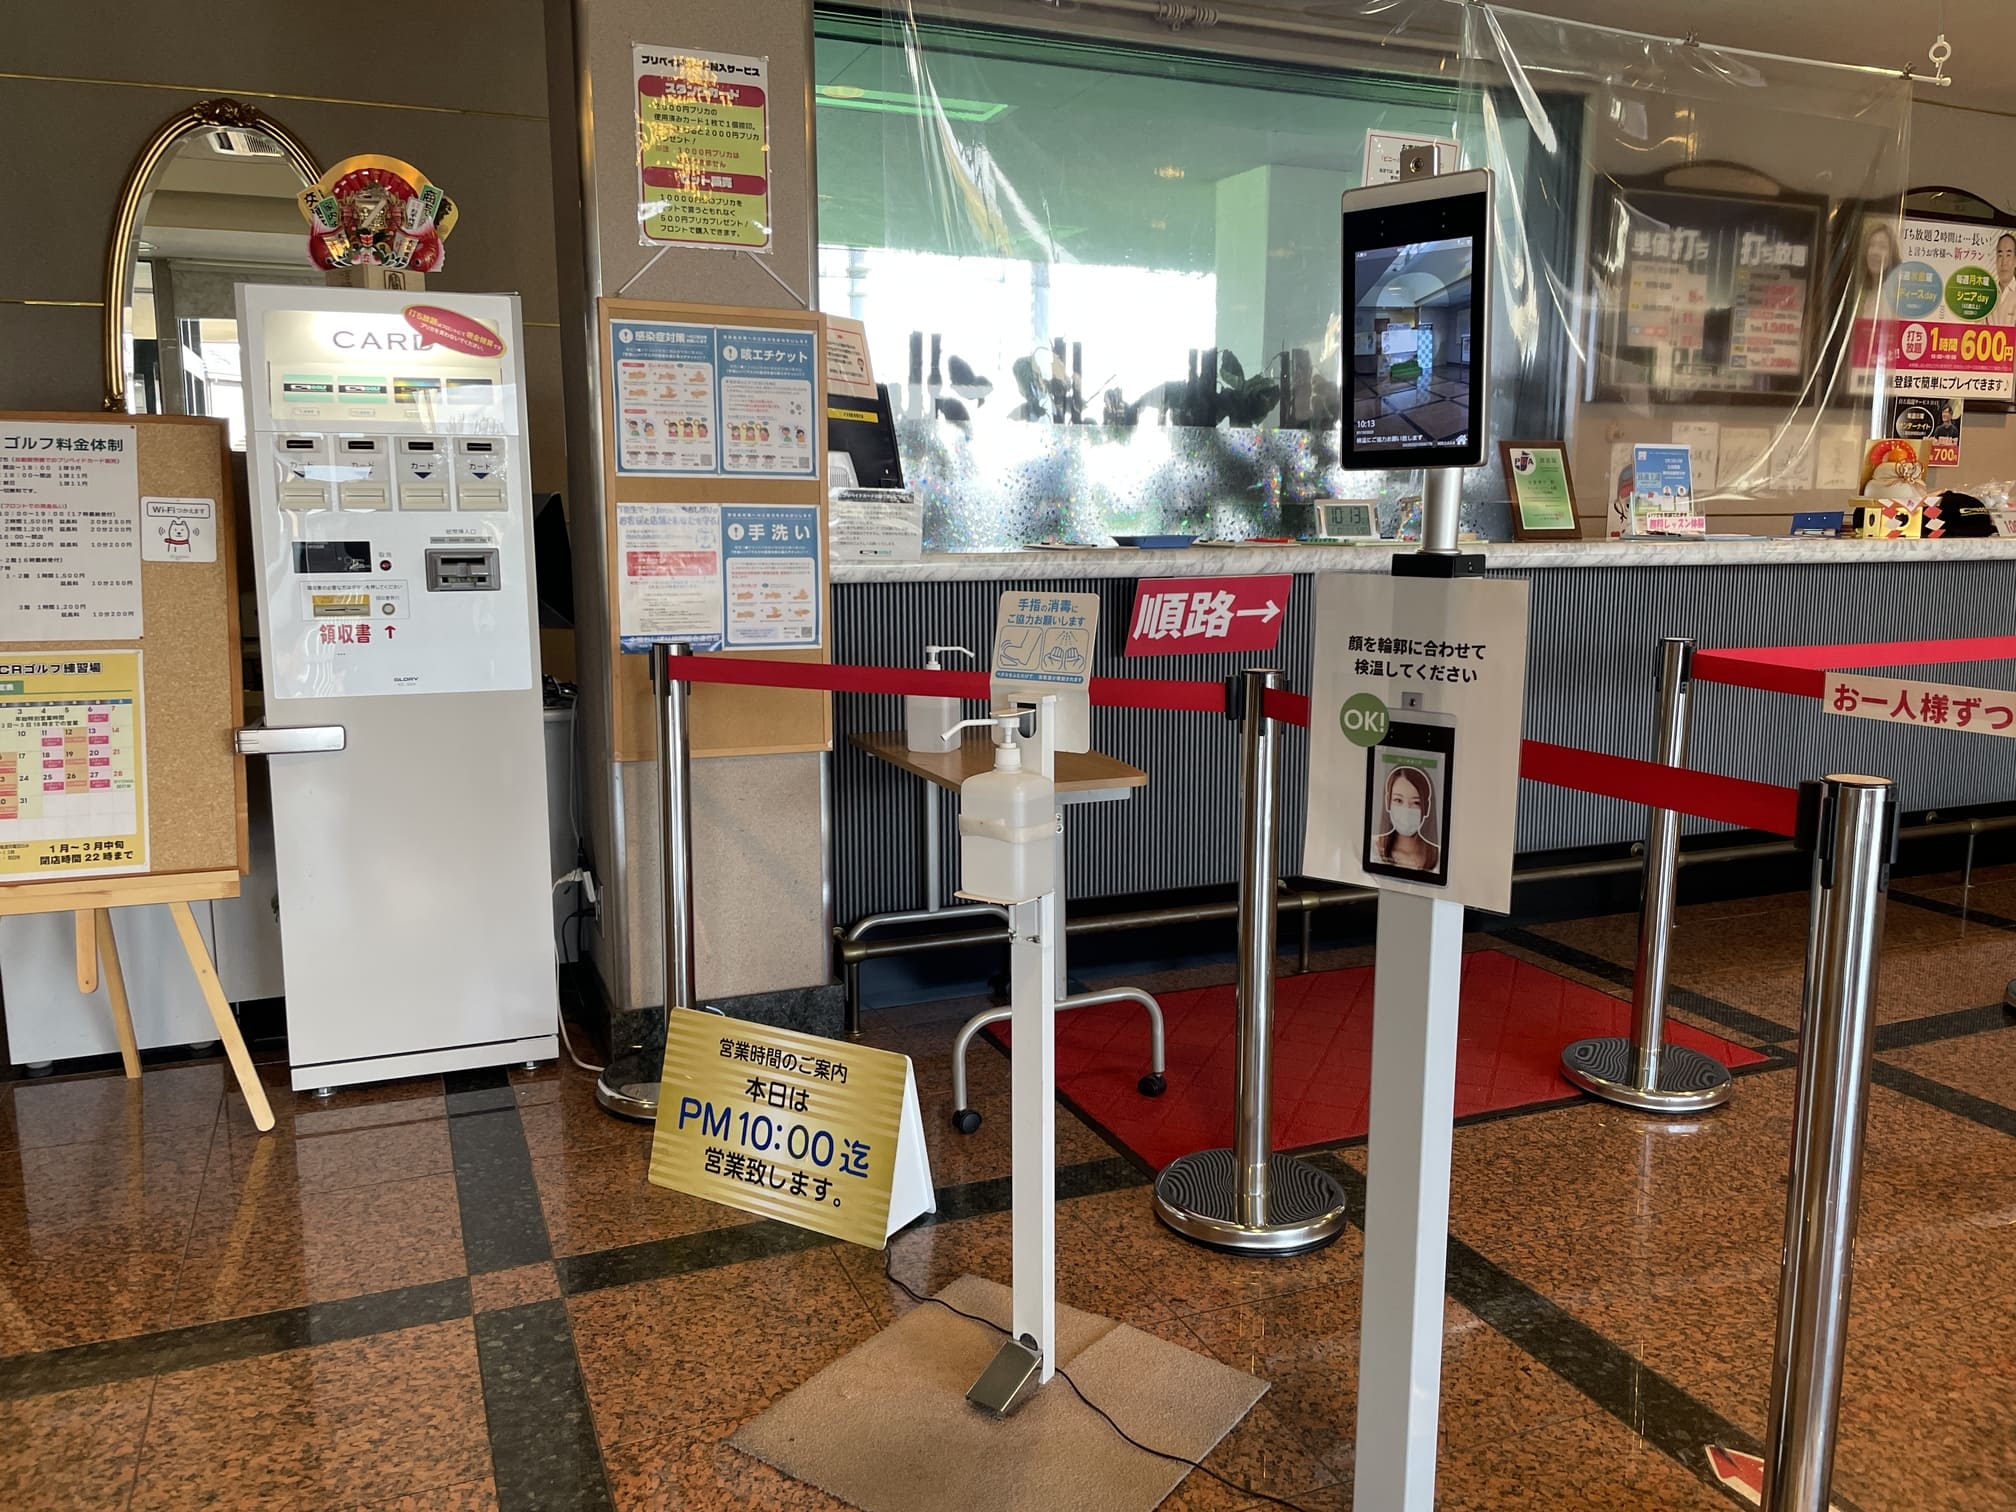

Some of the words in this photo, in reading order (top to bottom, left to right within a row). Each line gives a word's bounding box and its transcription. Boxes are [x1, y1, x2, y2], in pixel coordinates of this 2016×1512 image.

[333, 331, 433, 351] CARD
[1961, 329, 2014, 362] 600円
[1357, 420, 1376, 428] 10:13
[4, 436, 123, 452] ゴルフ料金体制
[410, 462, 434, 470] カード
[469, 463, 491, 471] カード
[748, 523, 811, 541] 手洗い
[1018, 598, 1079, 613] 手指の消毒に
[1133, 590, 1236, 640] 順路
[1008, 614, 1086, 626] ご協力お願いします
[320, 624, 371, 645] 領収書
[1348, 635, 1487, 660] 顔を輪郭に合わせて
[1354, 658, 1478, 683] 検温してください
[1833, 683, 2014, 730] お一人様ずつ
[1344, 708, 1386, 733] OK!
[719, 1038, 848, 1084] 営業時間のご案内
[745, 1077, 810, 1112] 本日は
[705, 1146, 842, 1208] 営業致します。
